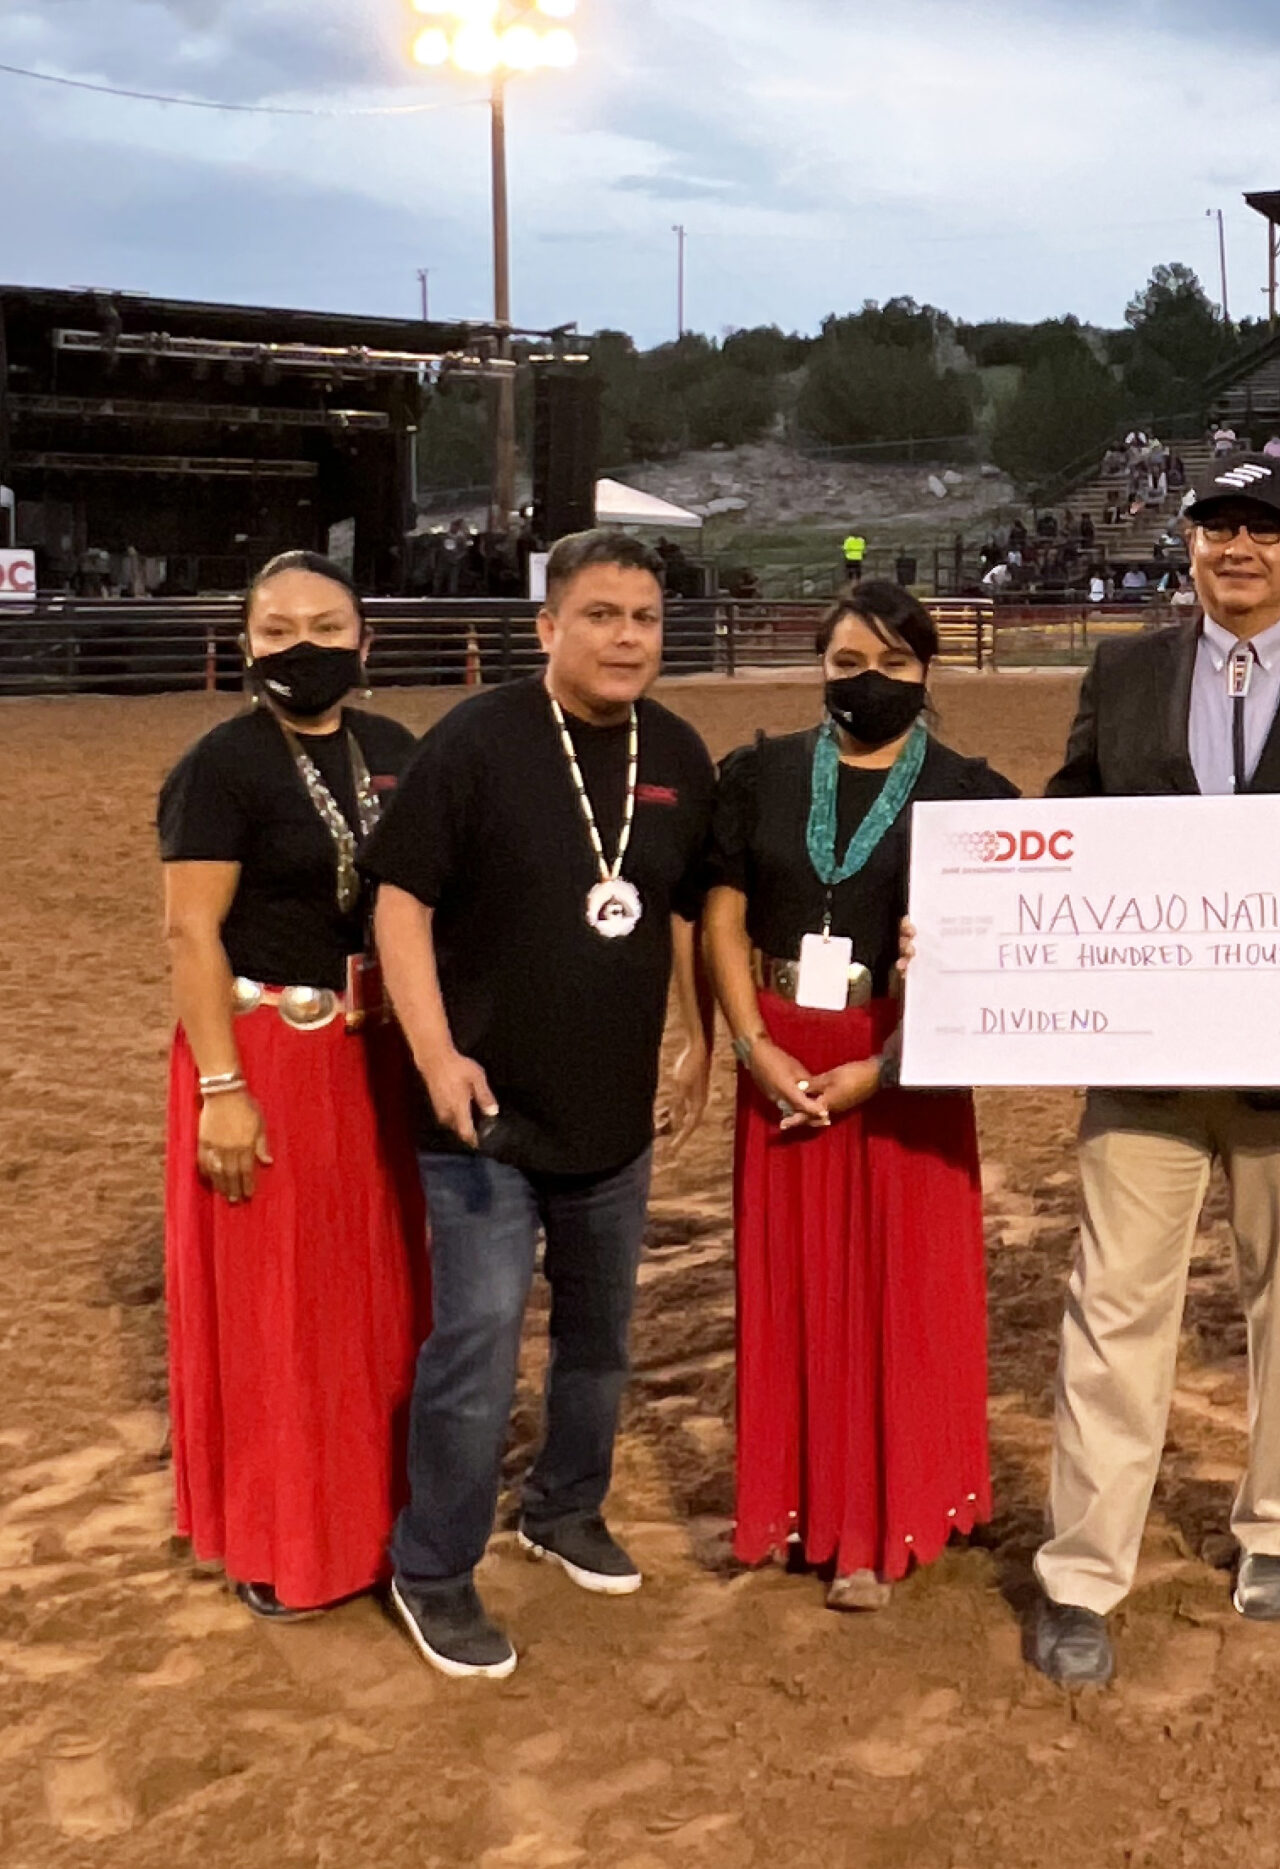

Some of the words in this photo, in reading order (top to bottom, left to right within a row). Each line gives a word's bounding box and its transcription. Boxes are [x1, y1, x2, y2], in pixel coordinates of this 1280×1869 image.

[986, 829, 1074, 862] DDC
[1017, 893, 1188, 935] NAVAJO
[999, 943, 1058, 968] FIVE
[1077, 943, 1193, 968] HUNDRED
[980, 1007, 1109, 1034] DIVIDEND
